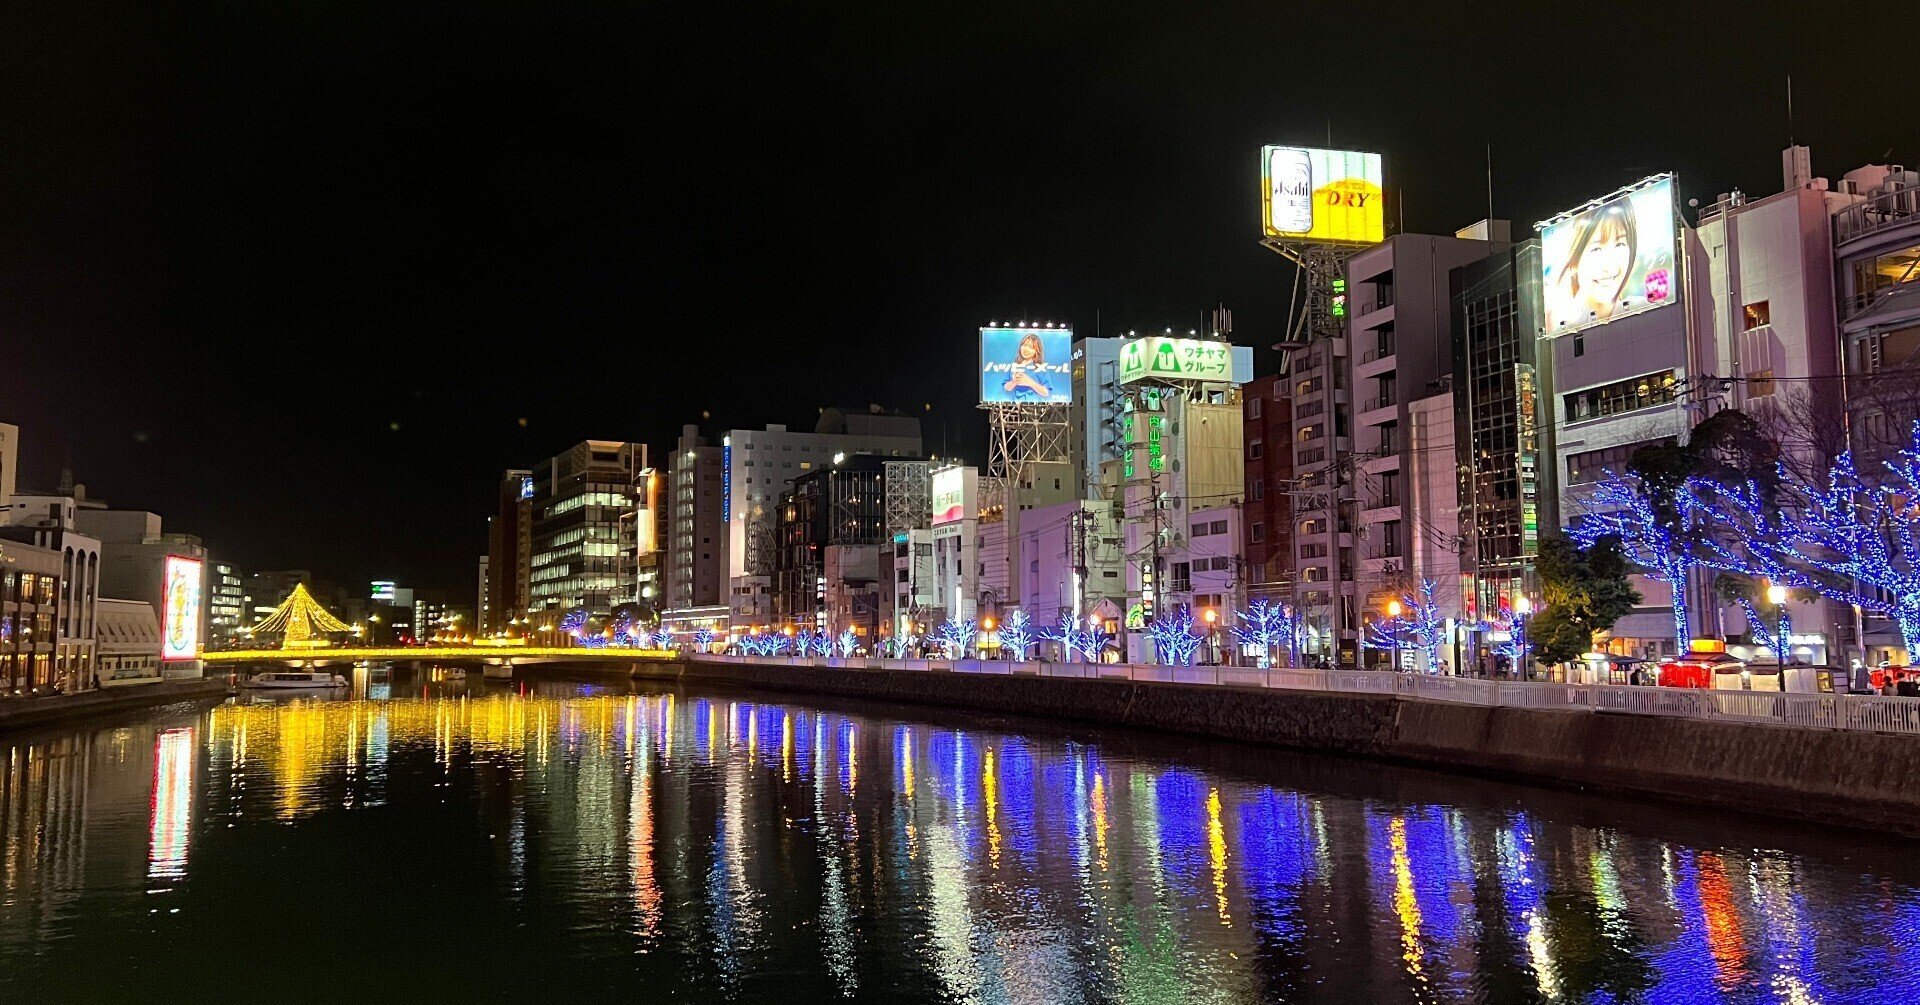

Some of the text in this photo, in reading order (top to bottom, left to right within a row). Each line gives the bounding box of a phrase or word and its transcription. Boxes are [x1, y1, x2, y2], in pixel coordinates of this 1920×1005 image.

[1274, 181, 1308, 197] Asahi
[1327, 190, 1370, 207] DRY
[1185, 347, 1226, 359] ウチヤマ
[984, 361, 1070, 373] ハッピーメール
[1185, 361, 1227, 374] グループ
[1124, 417, 1133, 477] 内山ビル
